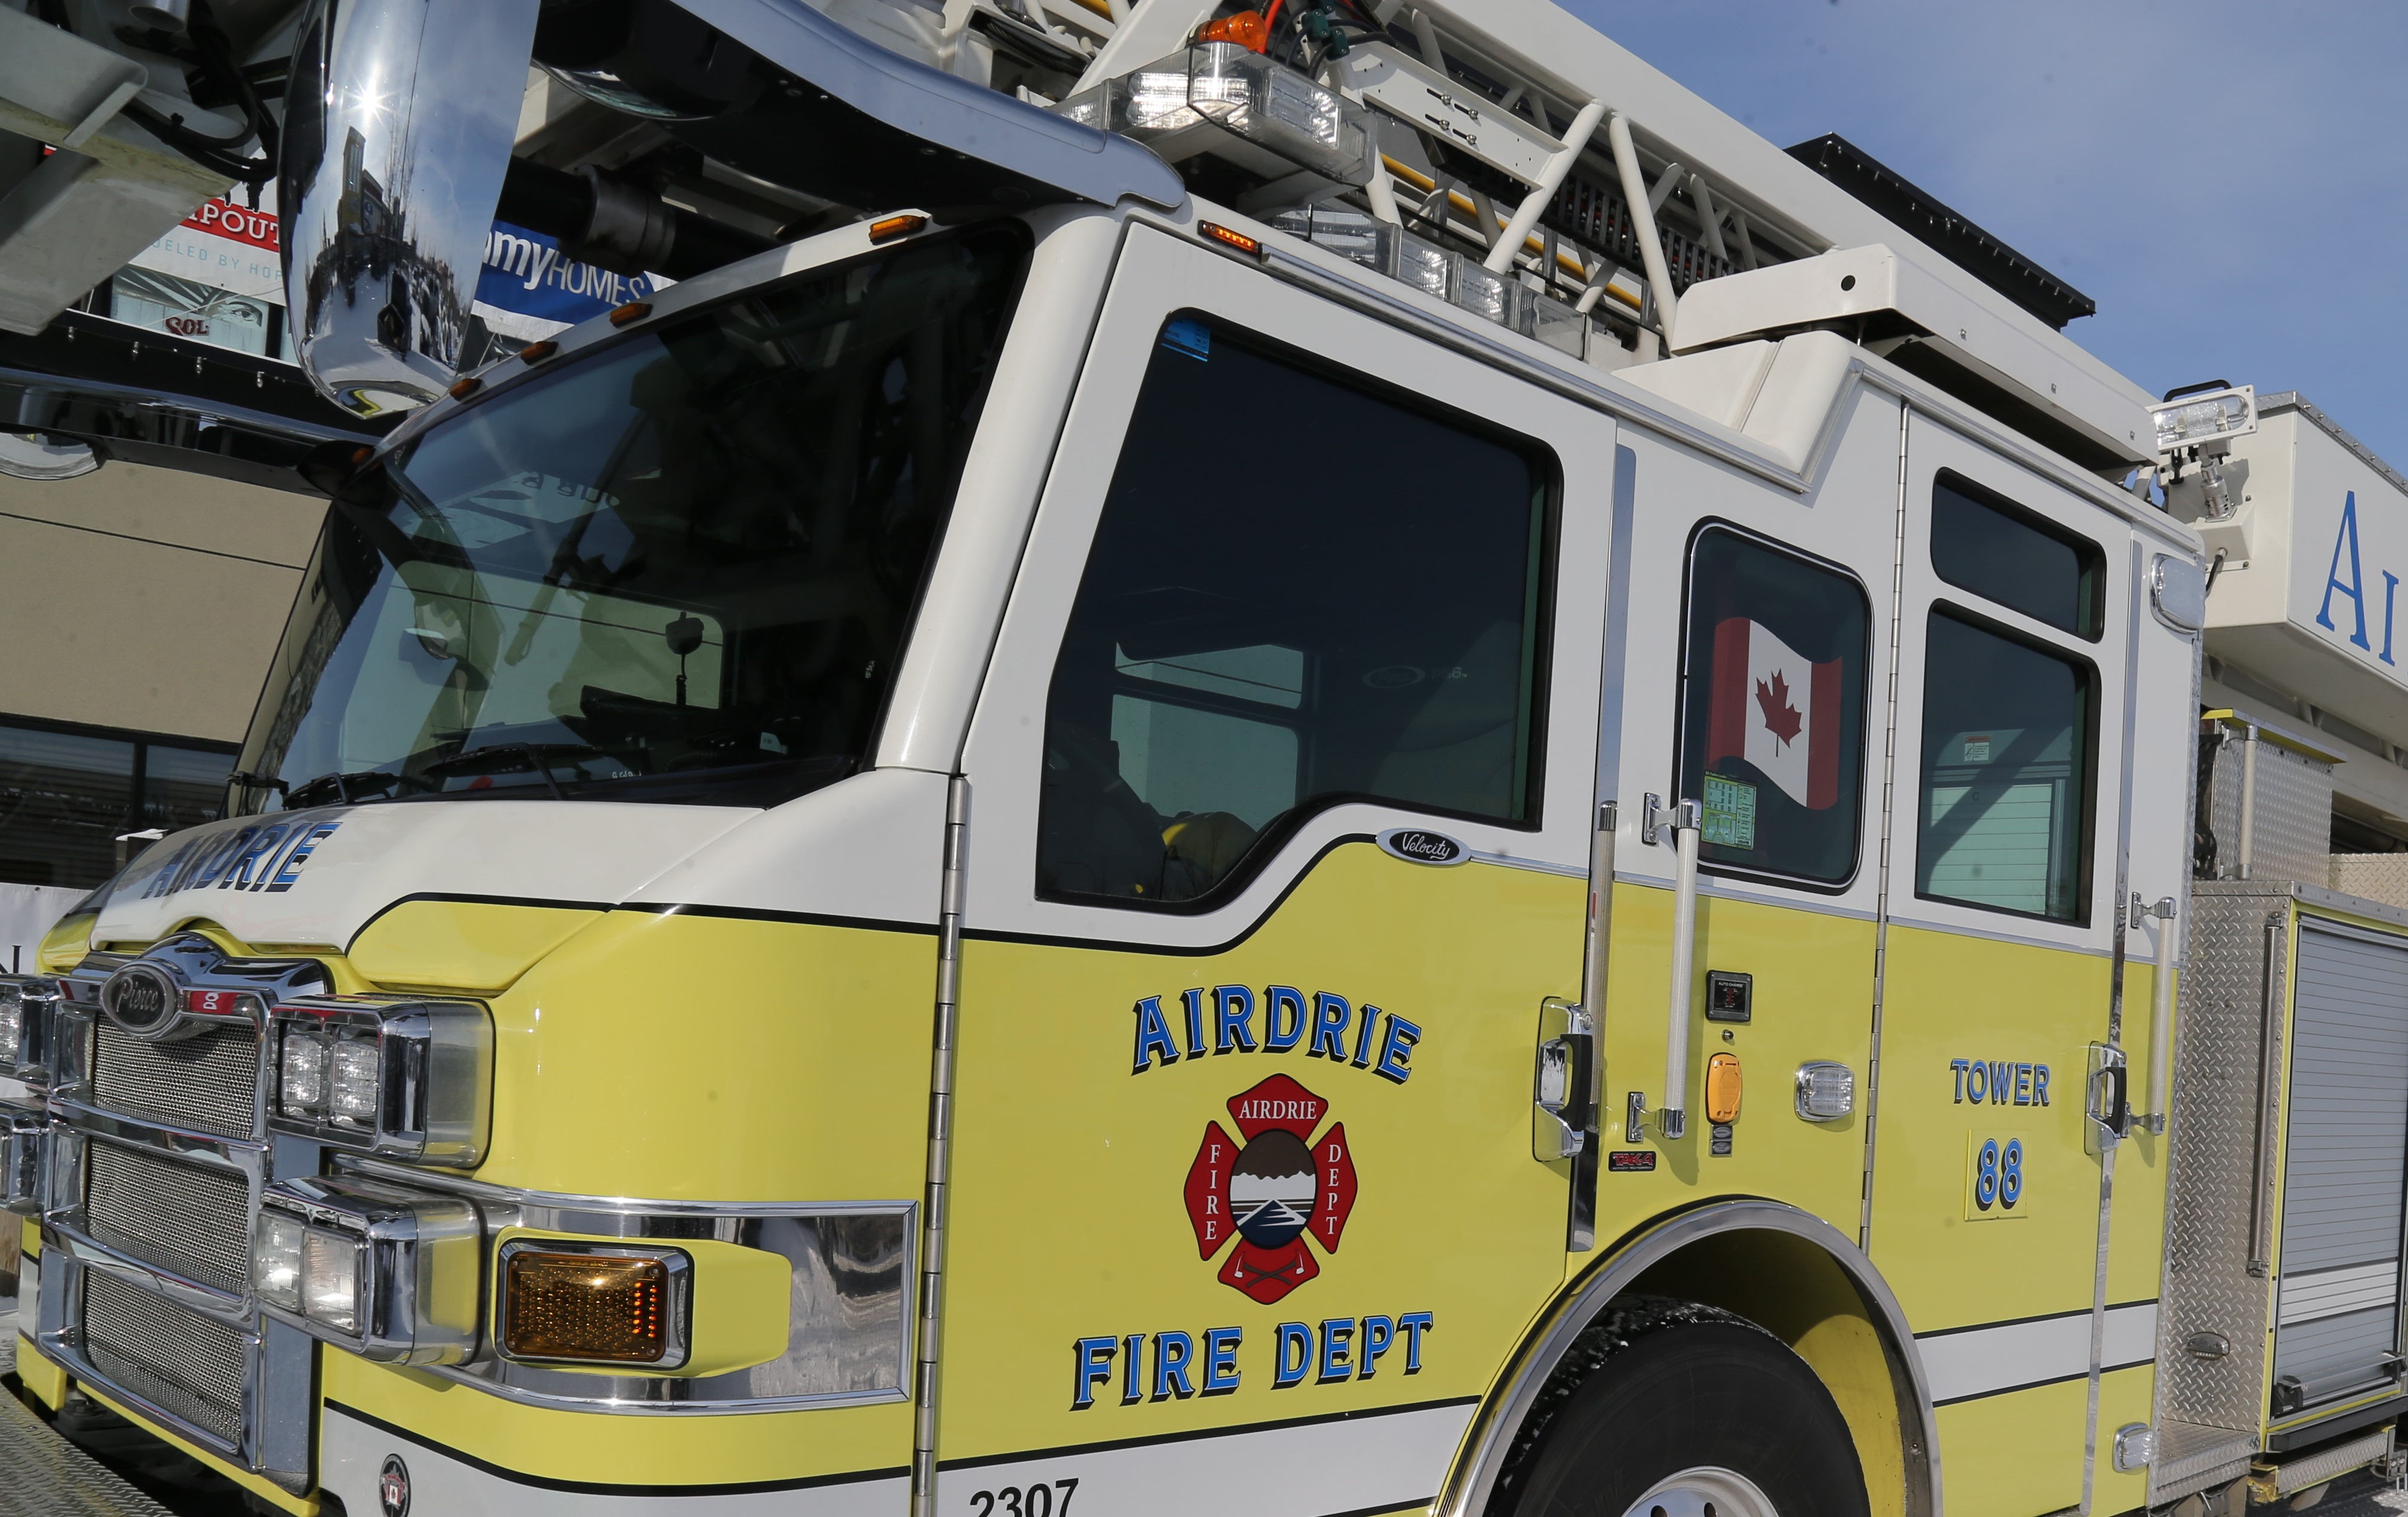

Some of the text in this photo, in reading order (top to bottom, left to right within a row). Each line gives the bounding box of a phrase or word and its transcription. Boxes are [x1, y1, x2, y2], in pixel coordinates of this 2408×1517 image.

[219, 254, 240, 269] BY
[250, 262, 282, 281] HOP
[2316, 490, 2400, 667] AI
[140, 821, 344, 900] AIRDRIE
[1402, 832, 1451, 860] Velocity
[116, 976, 159, 1013] Pierce
[1132, 984, 1422, 1085] AIRDRIE
[1238, 1099, 1317, 1121] AIRDRIE
[1950, 1058, 2050, 1107] TOWER
[1326, 1143, 1342, 1236] DEPT
[1613, 1153, 1653, 1166] TAK-4
[1976, 1137, 2023, 1211] 88
[1205, 1144, 1221, 1241] FIRE
[1069, 1311, 1433, 1412] FIRE DEPT
[970, 1477, 1079, 1517] 2307
